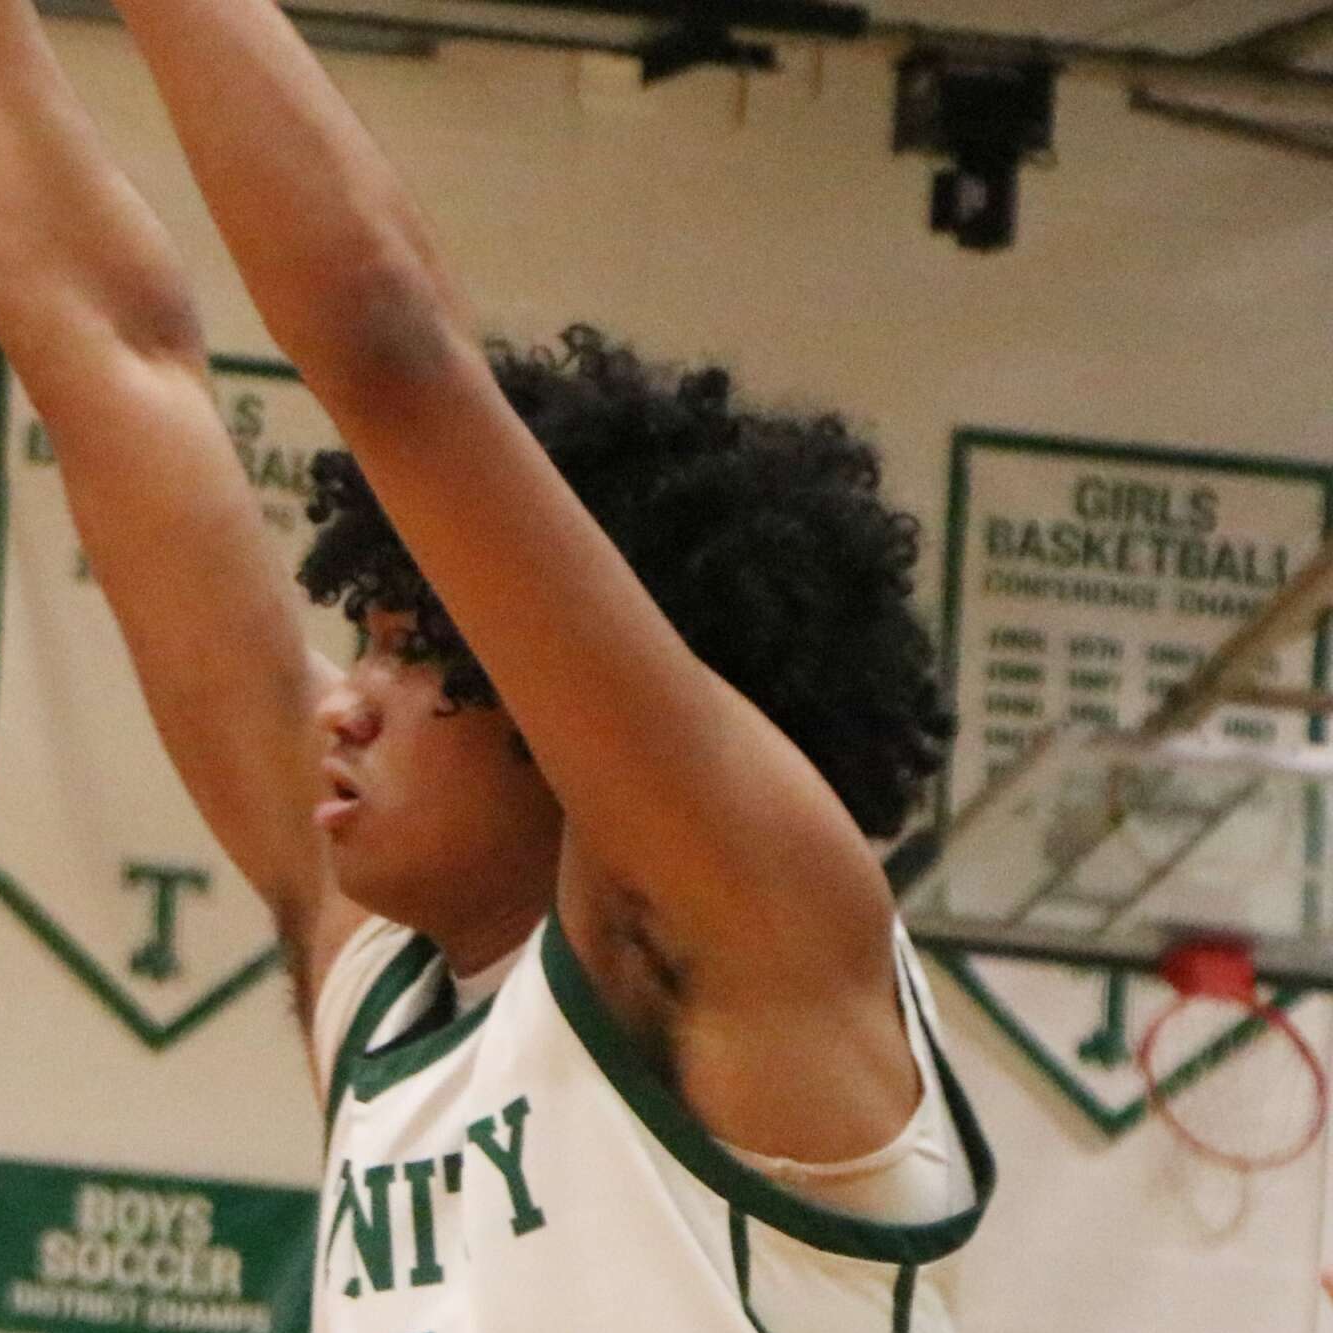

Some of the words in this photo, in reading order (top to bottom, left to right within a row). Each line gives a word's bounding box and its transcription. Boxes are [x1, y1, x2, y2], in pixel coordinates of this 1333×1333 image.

[1073, 474, 1222, 534] GIRLS
[984, 517, 1289, 587] BASKETBALL
[122, 862, 211, 982] T
[76, 1183, 214, 1249] BOYS
[40, 1228, 243, 1299] SOCCER
